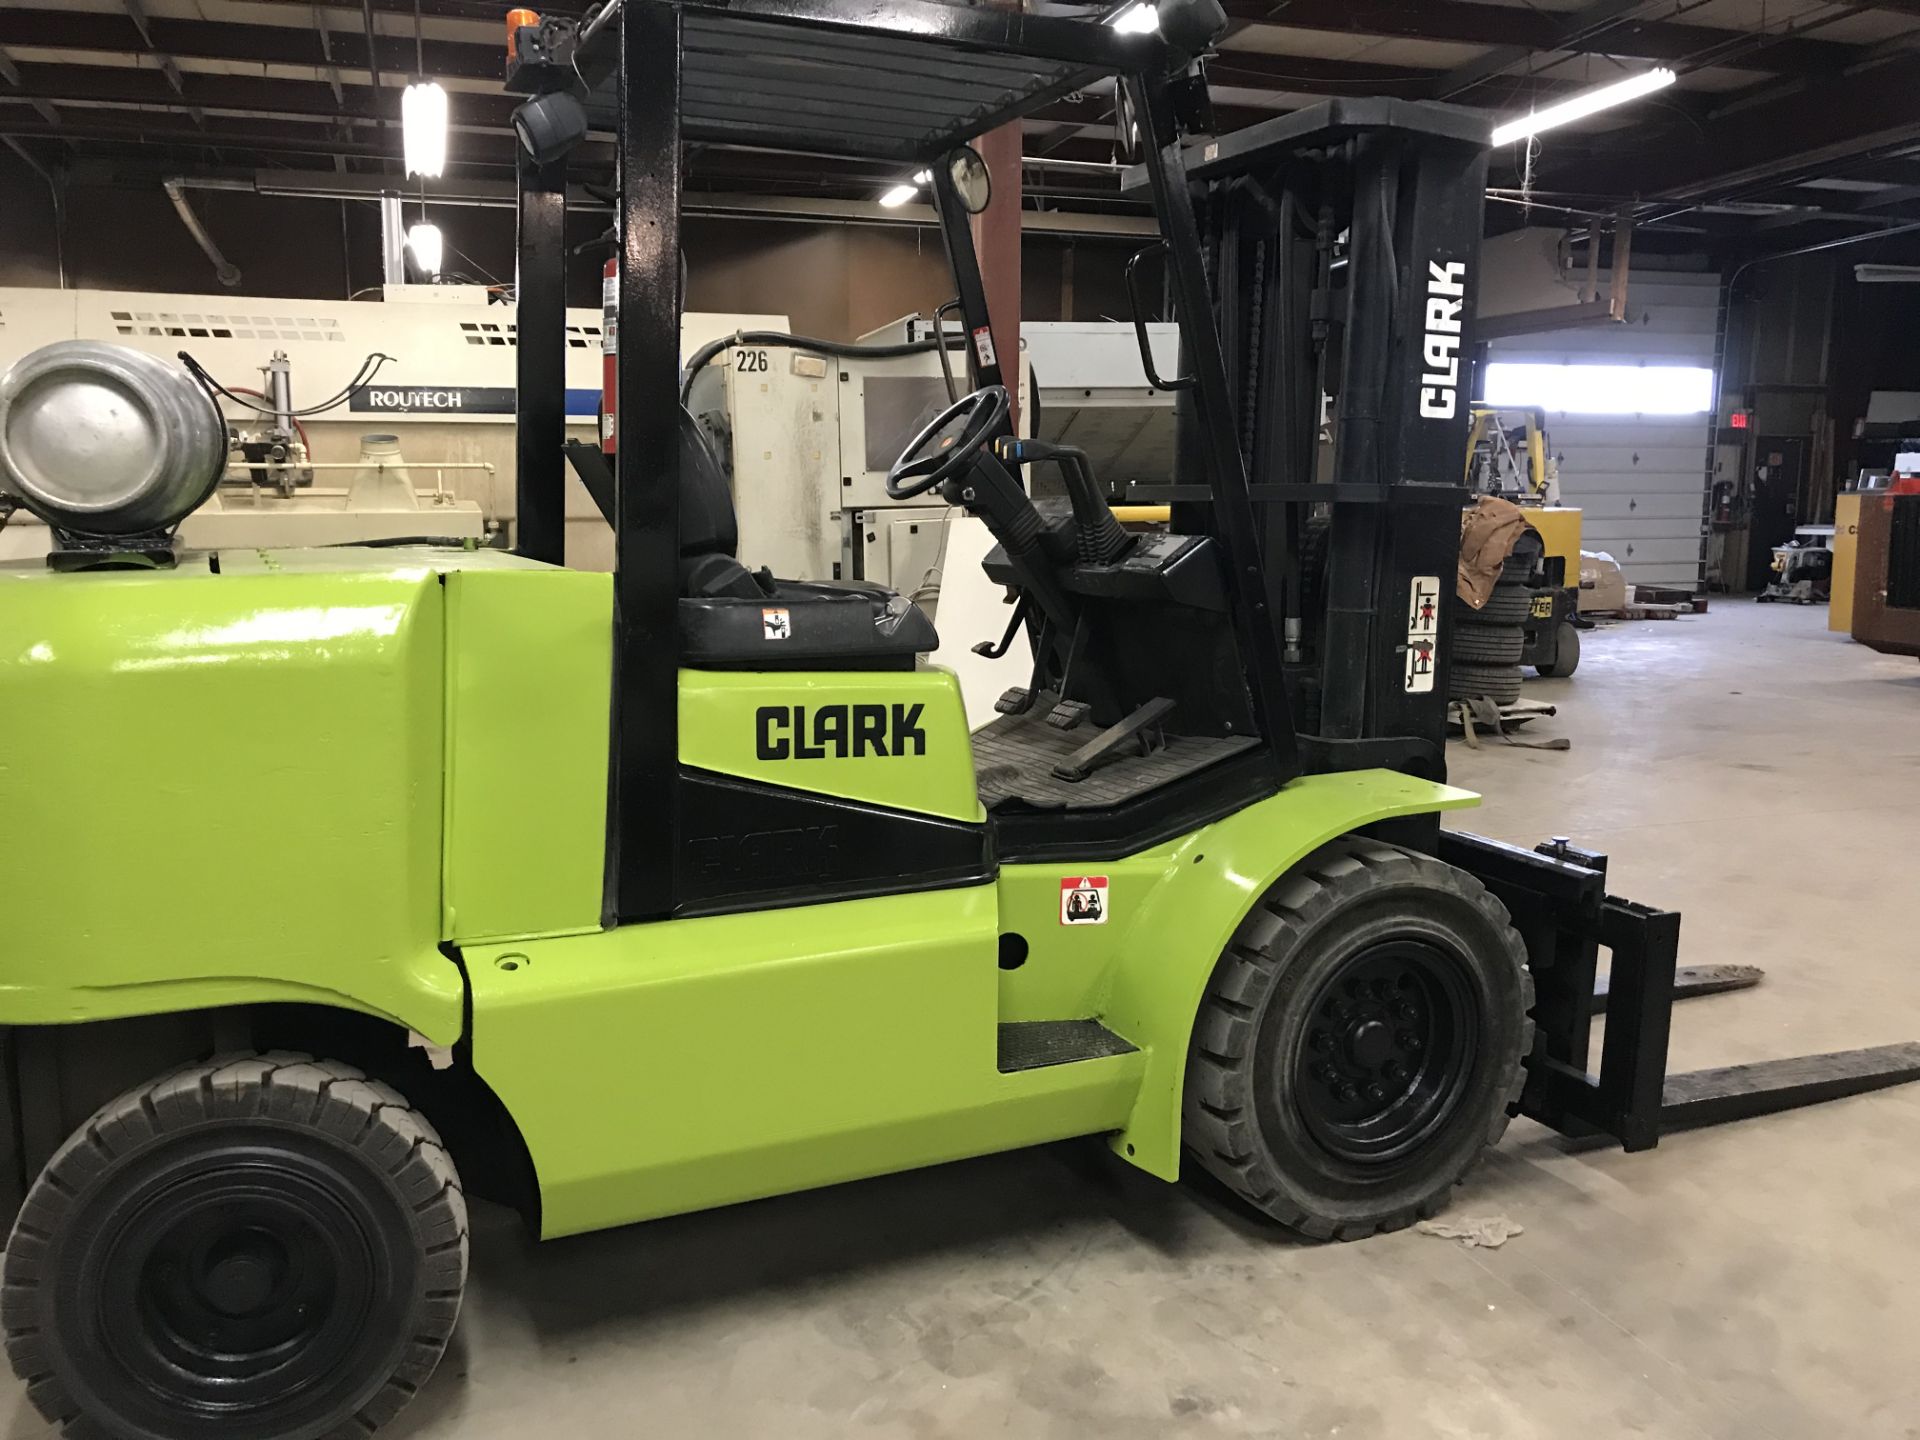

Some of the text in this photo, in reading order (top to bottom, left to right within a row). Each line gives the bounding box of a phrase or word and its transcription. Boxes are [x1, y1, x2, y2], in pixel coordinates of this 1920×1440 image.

[1420, 260, 1465, 419] CLARK
[736, 350, 768, 372] 226
[370, 390, 462, 408] ROUTECH
[756, 704, 926, 760] CLARK
